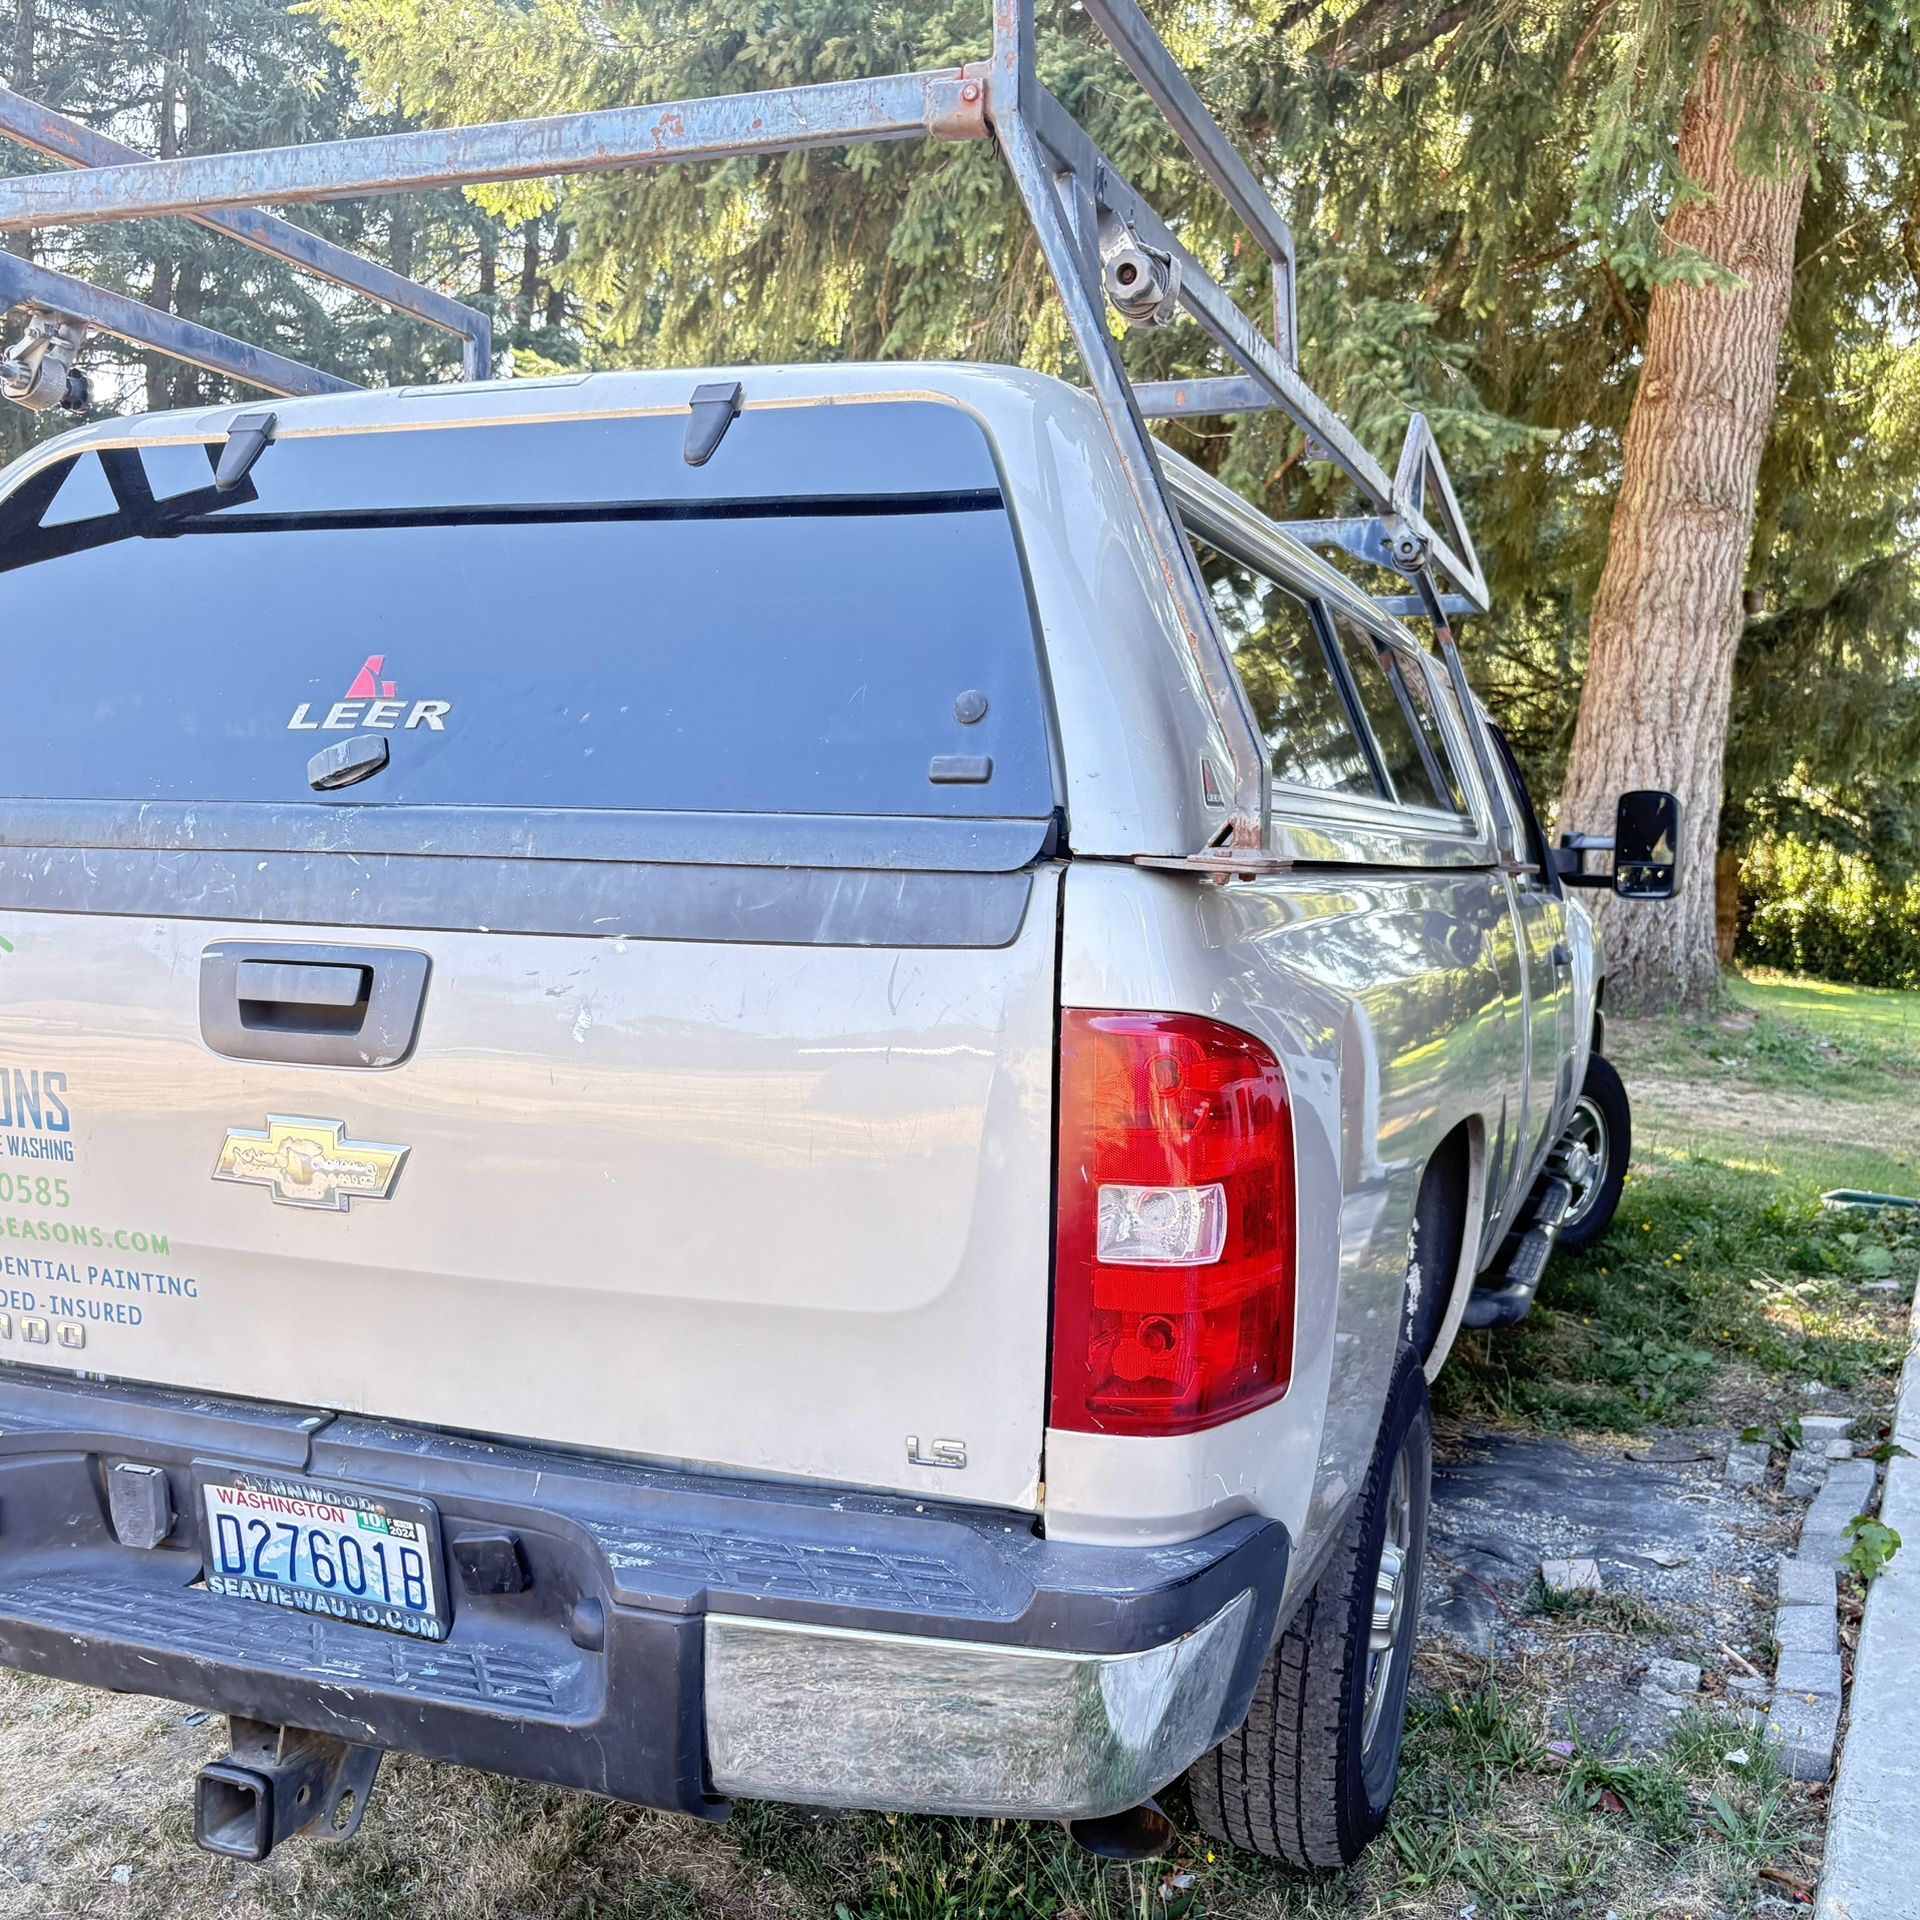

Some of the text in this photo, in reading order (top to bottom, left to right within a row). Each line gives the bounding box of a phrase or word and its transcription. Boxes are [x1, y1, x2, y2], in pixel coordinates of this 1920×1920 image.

[286, 699, 452, 731] LEER
[6, 1135, 74, 1162] WASHING
[0, 1172, 70, 1208] 0585
[0, 1256, 198, 1298] ENTIAL PAINTING
[906, 1435, 967, 1470] LS
[216, 1488, 345, 1524] WASHINGTON
[359, 1511, 380, 1528] 10
[389, 1526, 416, 1540] 2024
[216, 1513, 428, 1611] D27601B
[209, 1576, 440, 1639] SEAVIEWAUTO.COM
